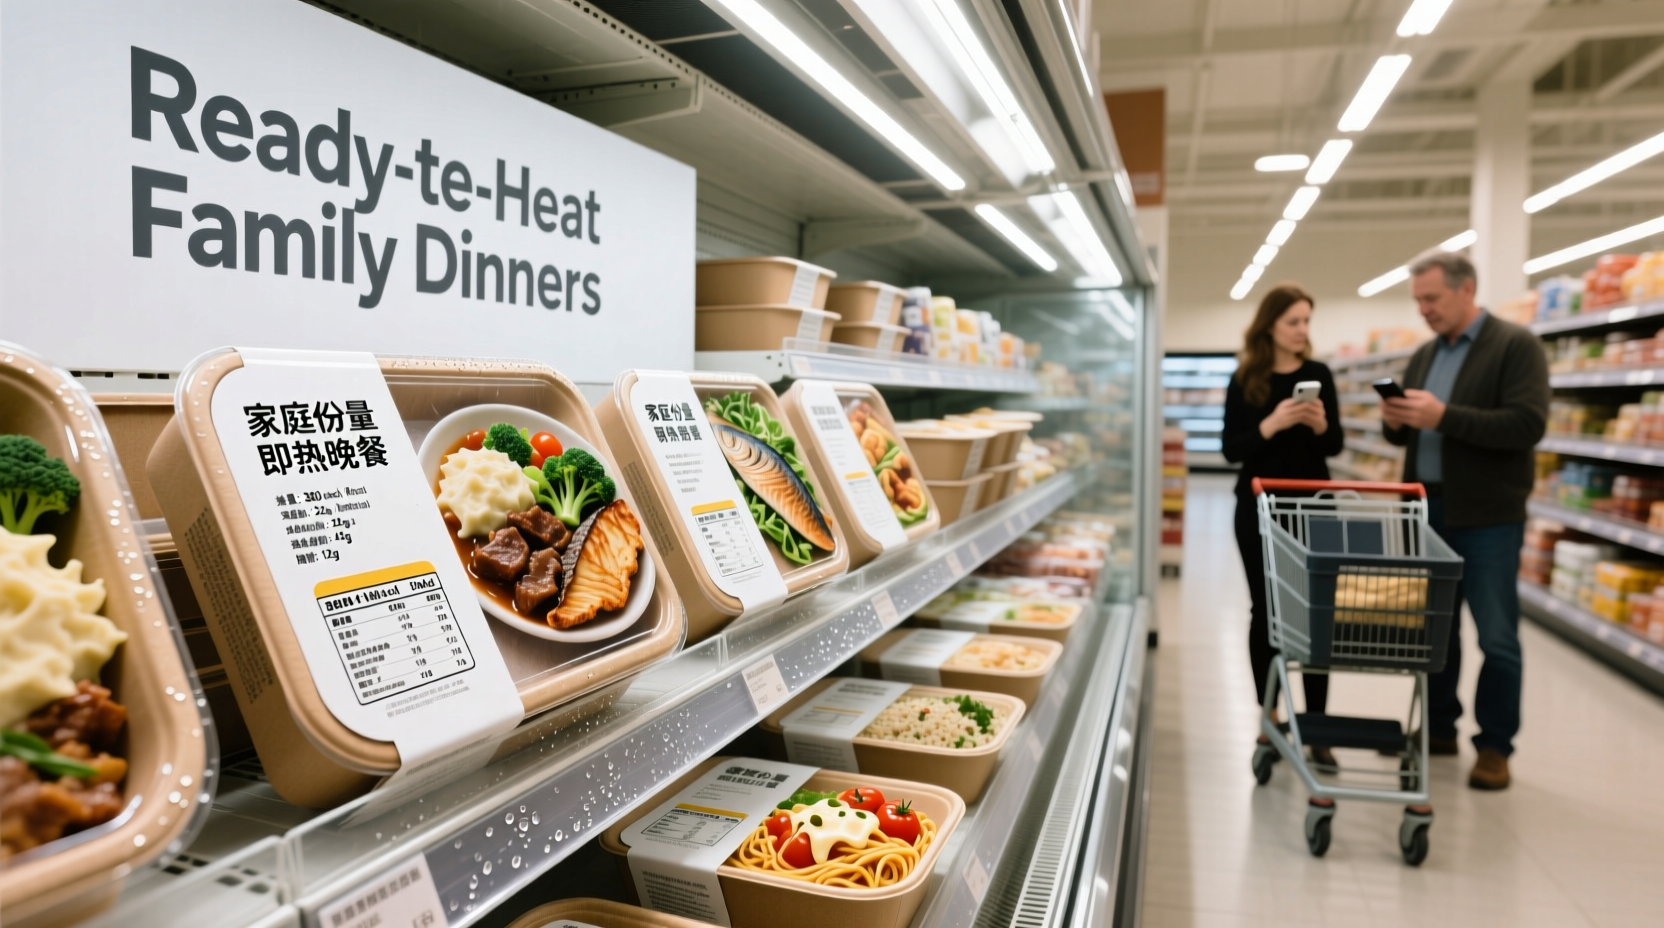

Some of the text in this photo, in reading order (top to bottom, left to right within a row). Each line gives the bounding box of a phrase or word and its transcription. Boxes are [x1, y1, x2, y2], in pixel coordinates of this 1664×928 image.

[131, 45, 601, 244] Ready-te-Heat
[131, 165, 601, 316] Family Dinners
[243, 400, 378, 437] 家庭份量
[257, 435, 389, 476] 即热晚餐
